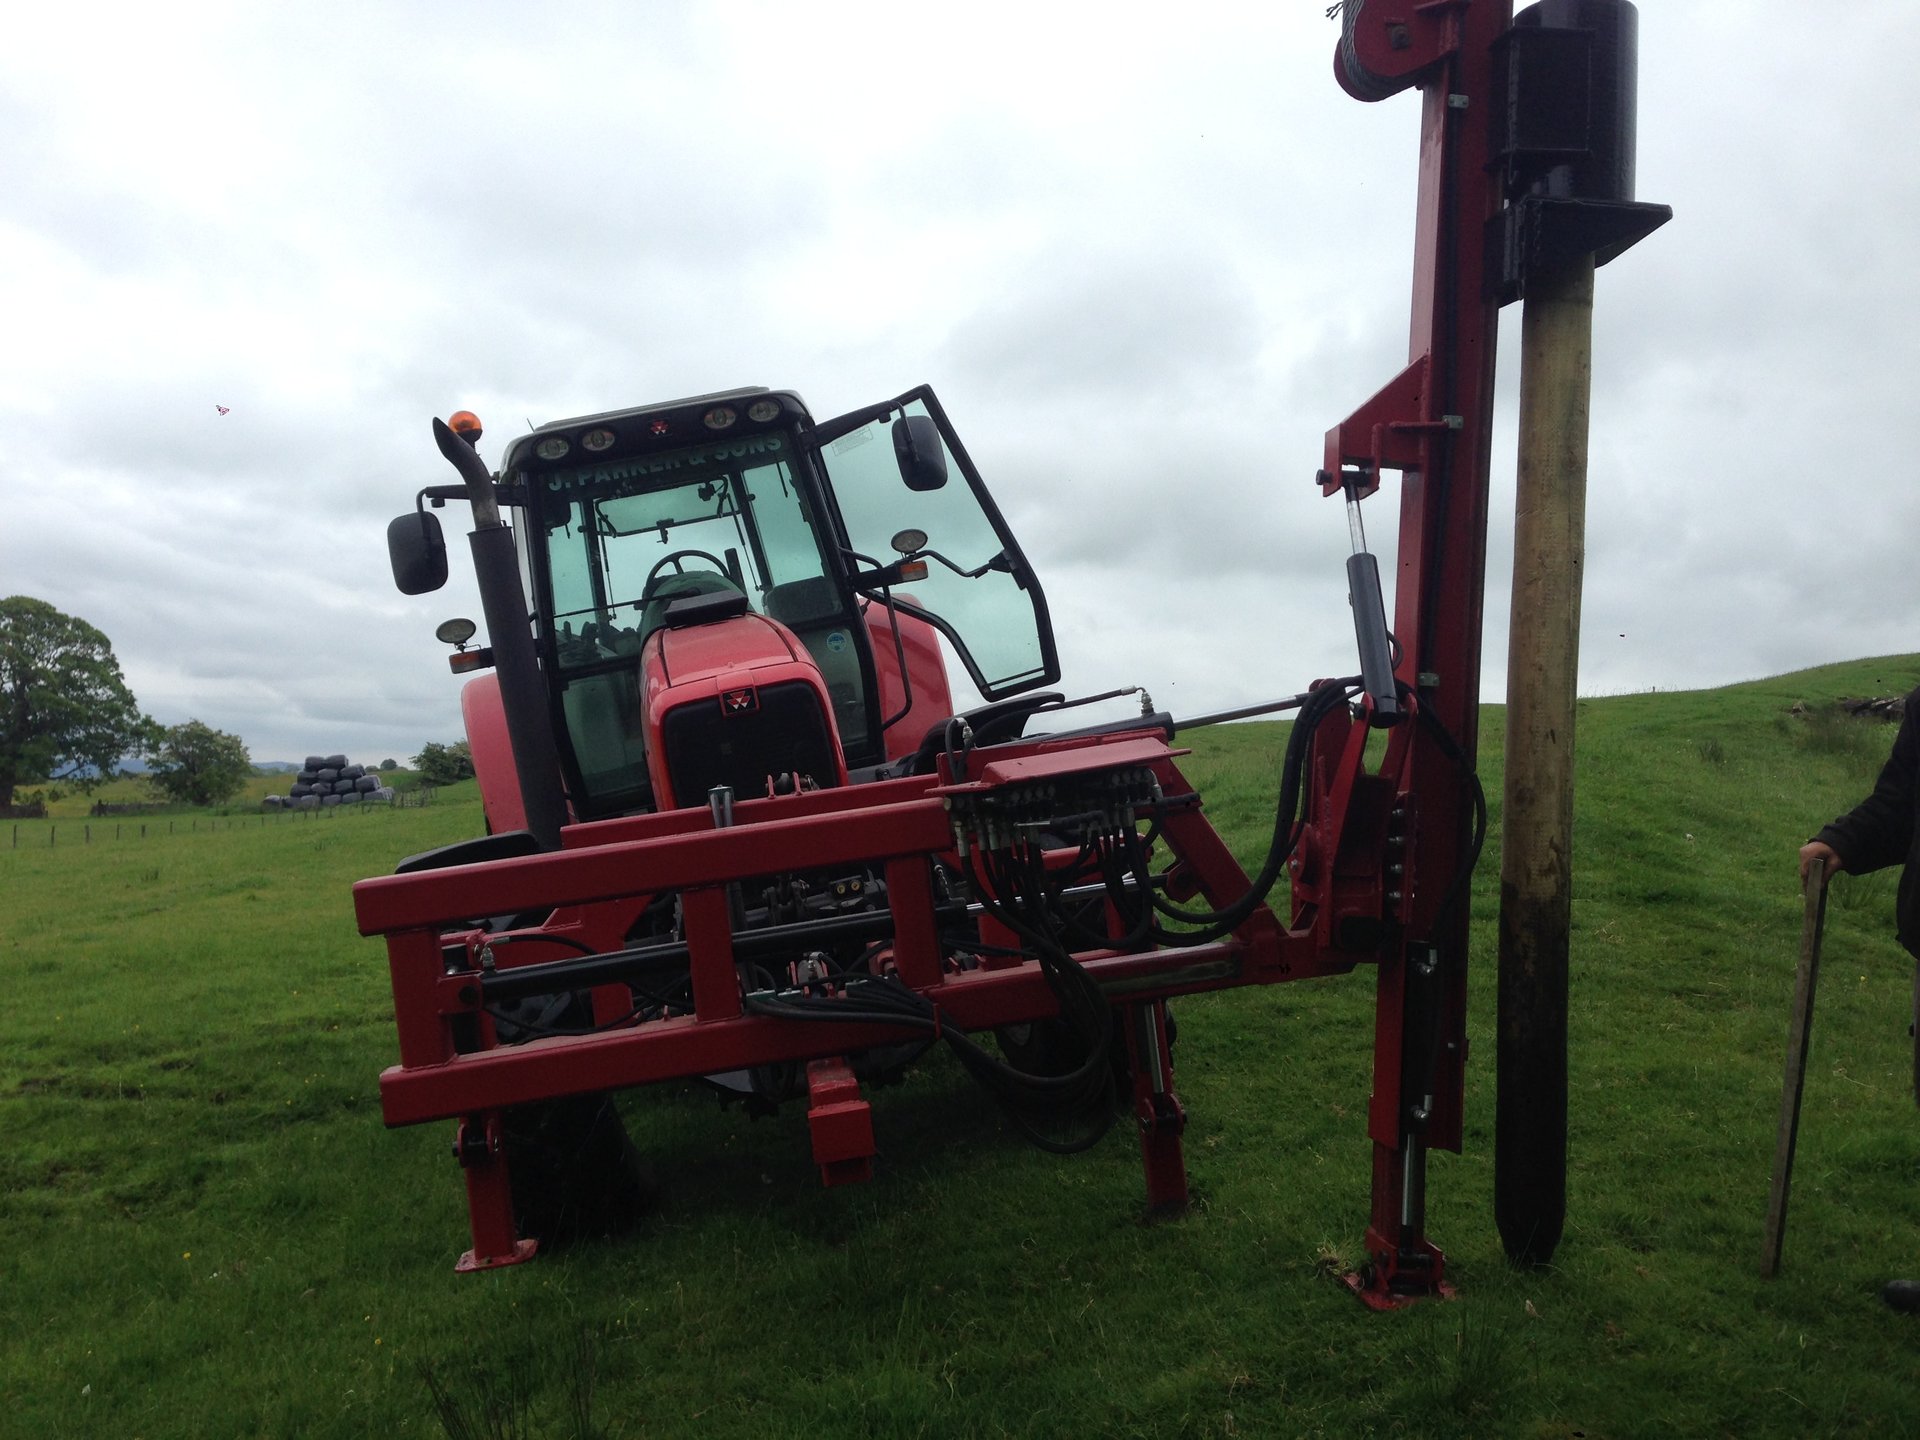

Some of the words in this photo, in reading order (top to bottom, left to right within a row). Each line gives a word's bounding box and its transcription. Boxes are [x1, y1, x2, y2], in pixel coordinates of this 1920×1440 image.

[548, 470, 571, 491] J.
[688, 449, 707, 465] &
[713, 437, 782, 461] SONS
